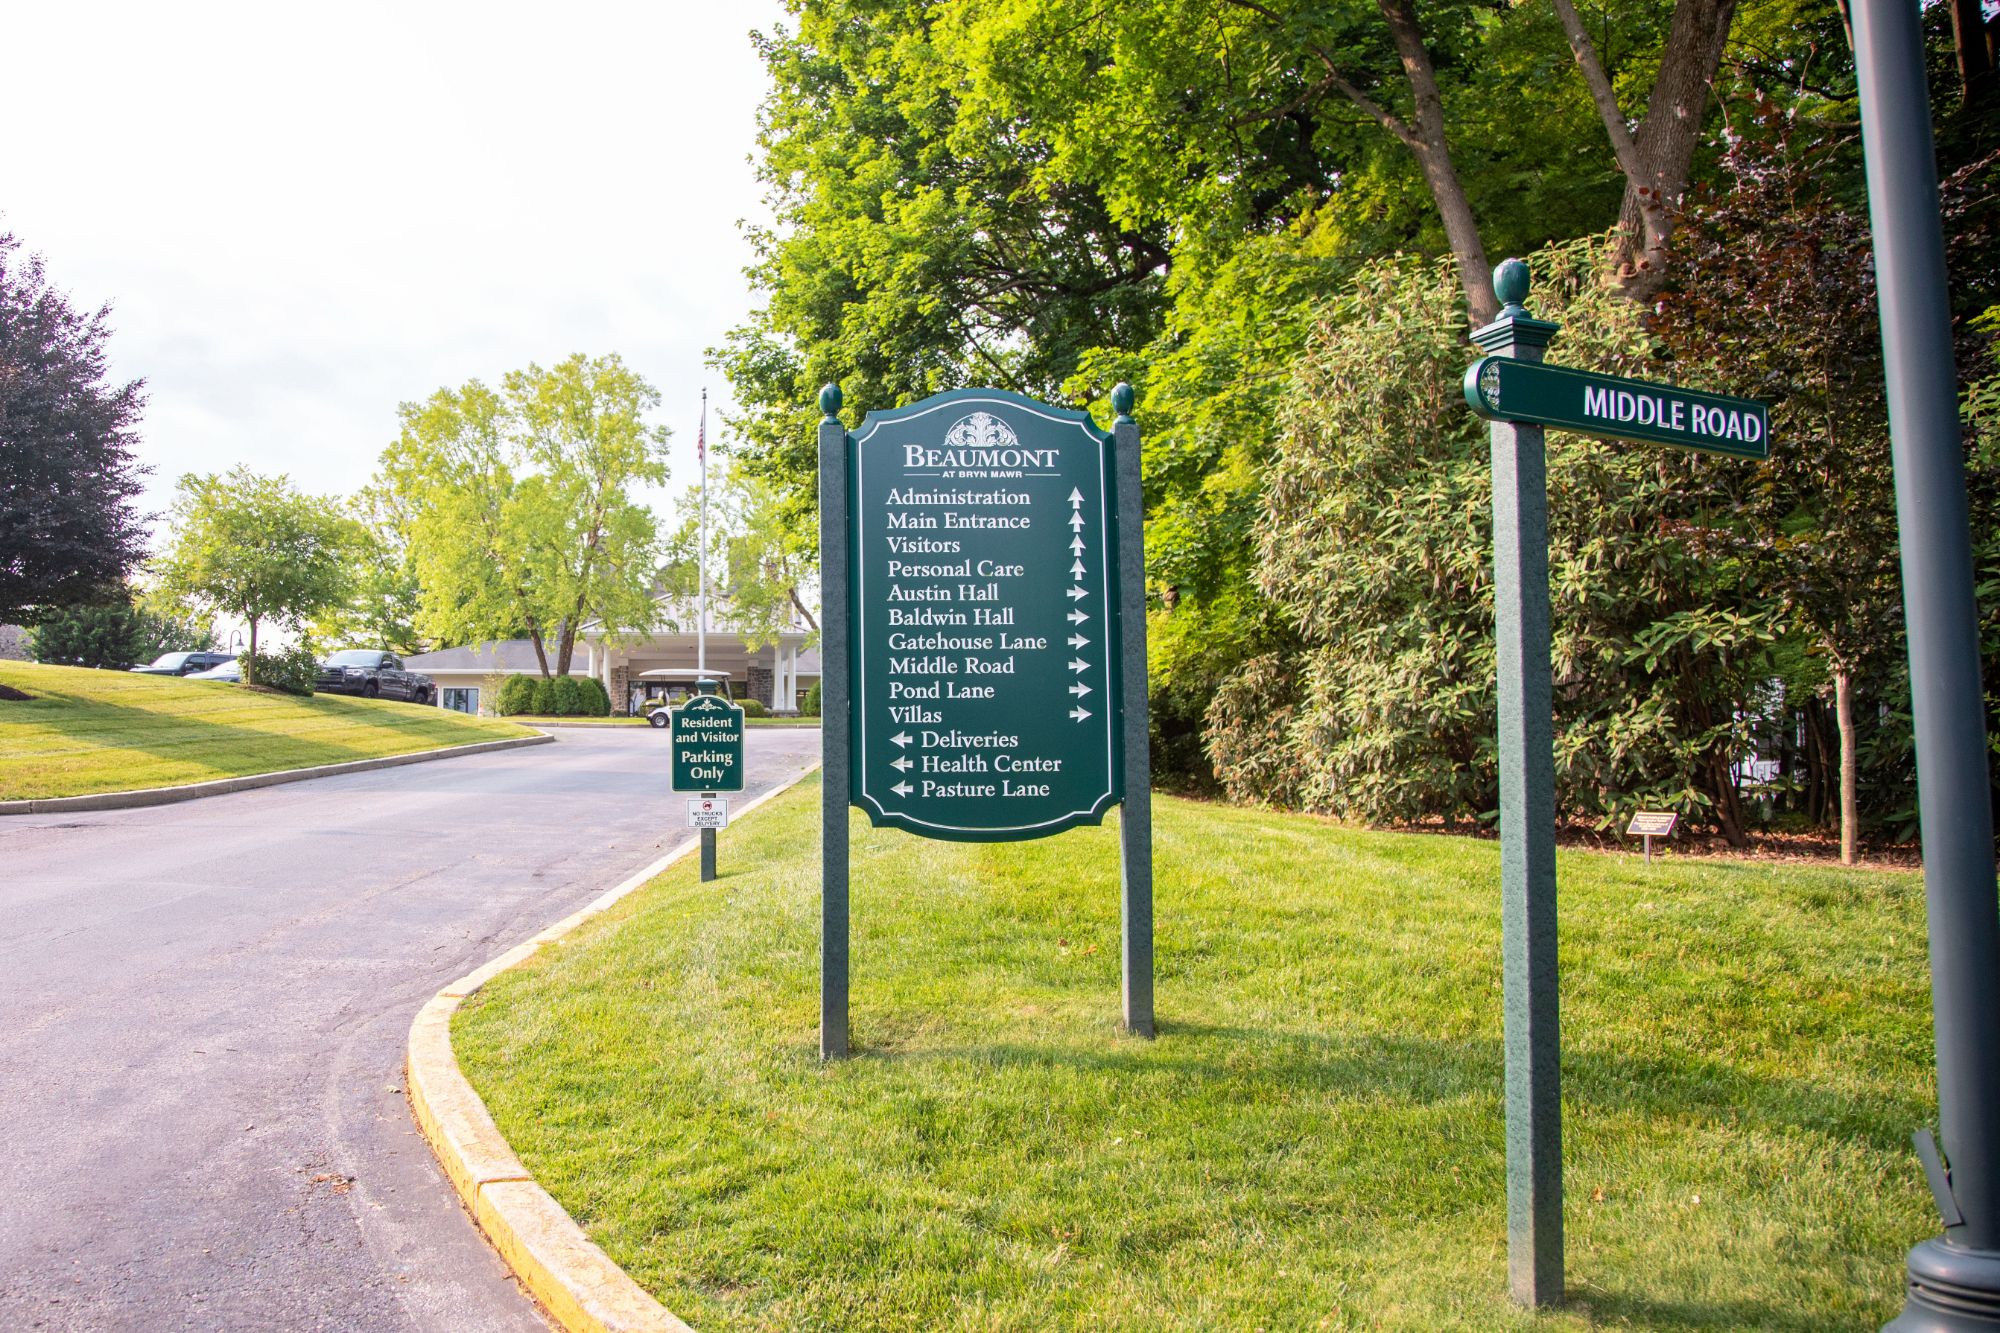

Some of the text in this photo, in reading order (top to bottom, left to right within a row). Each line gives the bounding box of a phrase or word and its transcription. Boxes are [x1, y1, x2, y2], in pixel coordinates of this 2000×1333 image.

[1584, 385, 1761, 443] MIDDLE ROAD
[903, 444, 1060, 468] BEAUMONT
[942, 470, 1023, 479] AT BRYN MAWR
[886, 487, 1032, 505] Administration
[886, 511, 1031, 529] Main Entrance
[886, 536, 961, 554] Visitors
[887, 559, 1024, 578] Personal Care
[886, 583, 1000, 602] Austin Hall
[888, 607, 1015, 626] Baldwin Hall
[888, 632, 1047, 650] Gatehouse Lane
[888, 656, 1015, 675] Middle Road
[889, 680, 995, 699] Pond Lane
[681, 717, 733, 728] Resident
[888, 705, 942, 724] Villas
[675, 731, 740, 743] and Visitor
[921, 730, 1019, 748] Deliveries
[681, 751, 733, 766] Parking
[921, 754, 1062, 773] Health Center
[690, 766, 724, 782] Only
[921, 779, 1050, 798] Pasture Lane
